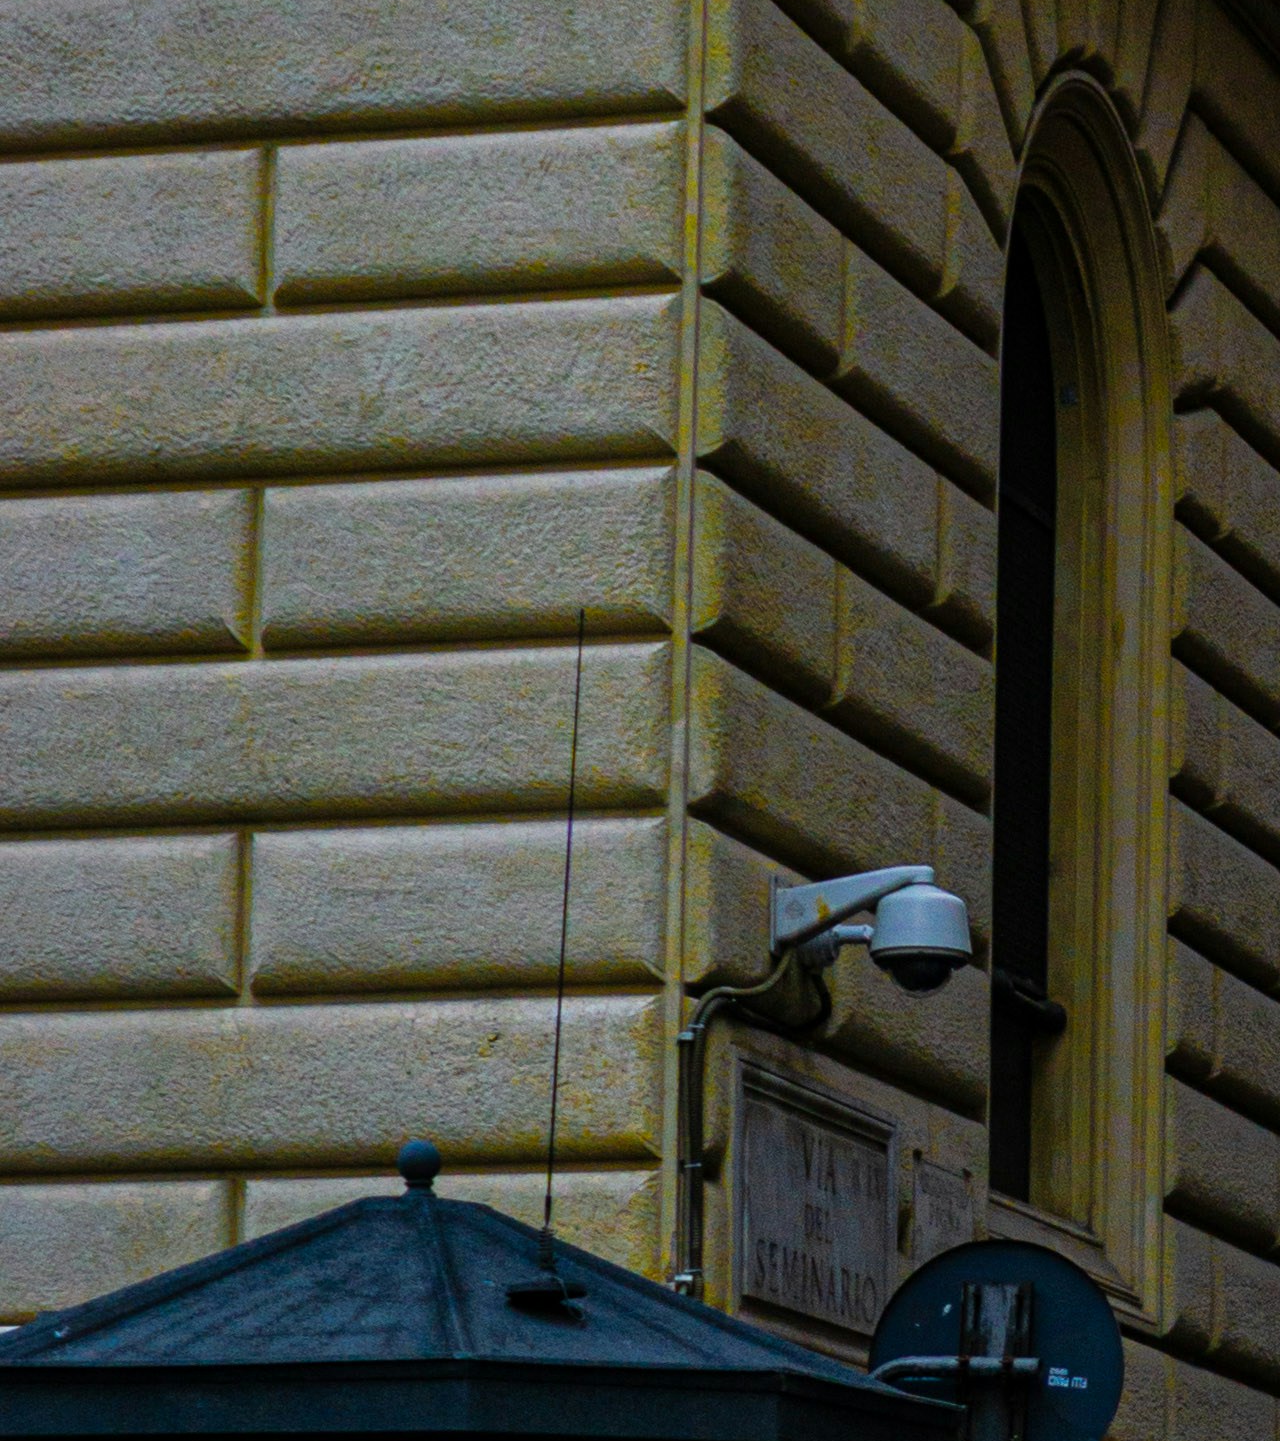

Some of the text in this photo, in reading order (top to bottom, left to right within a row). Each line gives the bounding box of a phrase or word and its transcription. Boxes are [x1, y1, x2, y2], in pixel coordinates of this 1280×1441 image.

[802, 1130, 836, 1196] VIA
[805, 1203, 833, 1245] DEL
[755, 1238, 877, 1324] SEMINARIO
